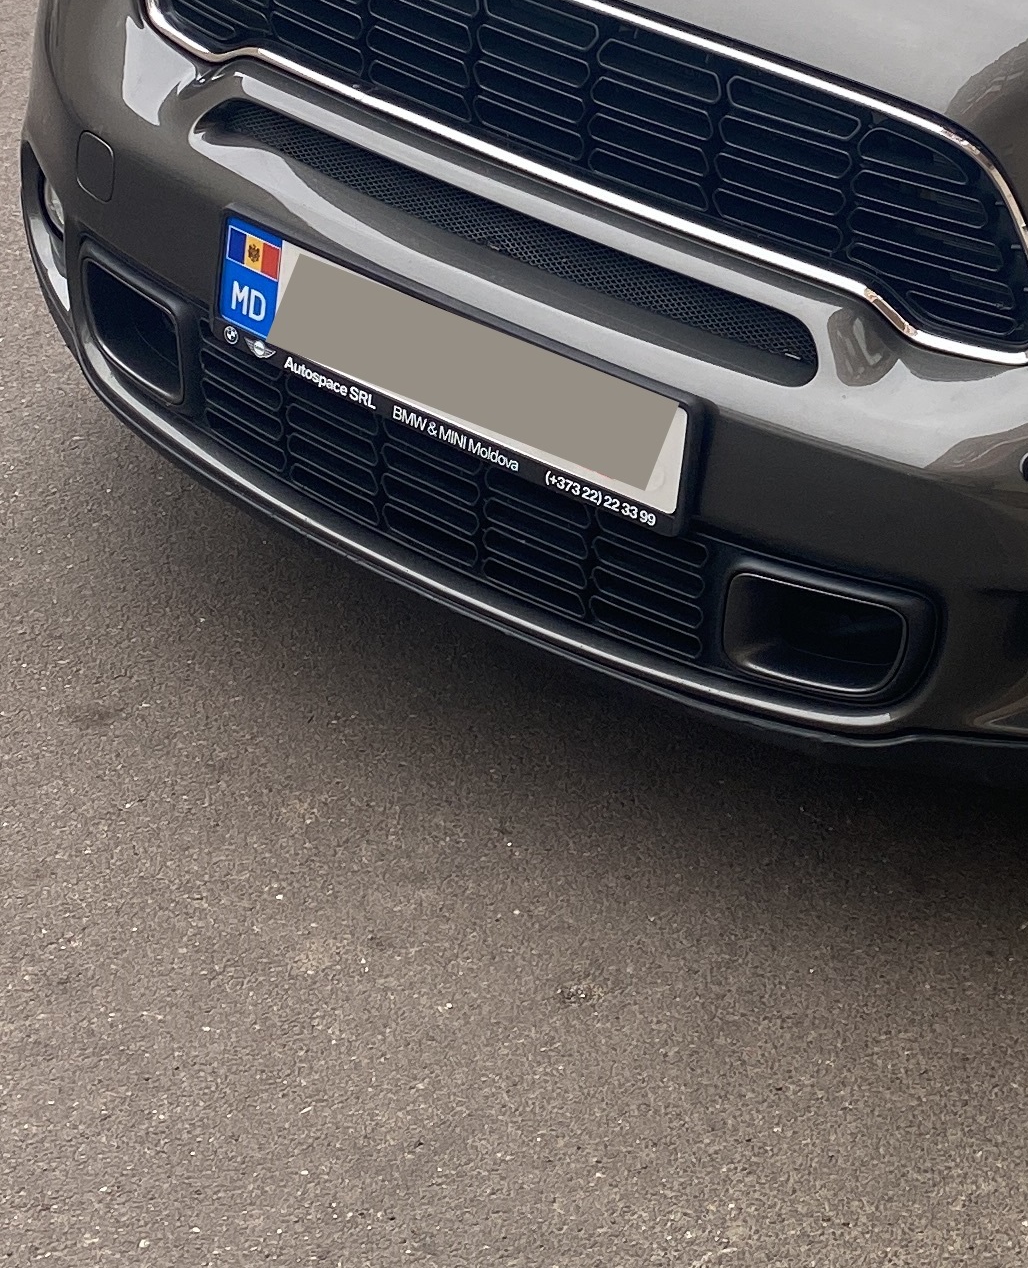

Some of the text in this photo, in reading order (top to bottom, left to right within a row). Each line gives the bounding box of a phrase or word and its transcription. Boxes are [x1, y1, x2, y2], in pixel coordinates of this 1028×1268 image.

[230, 280, 266, 322] MD
[284, 356, 377, 410] Autospace SRL
[392, 405, 519, 472] BMW & MINI Moldova
[545, 470, 656, 527] (+373 22) 22 33 99
